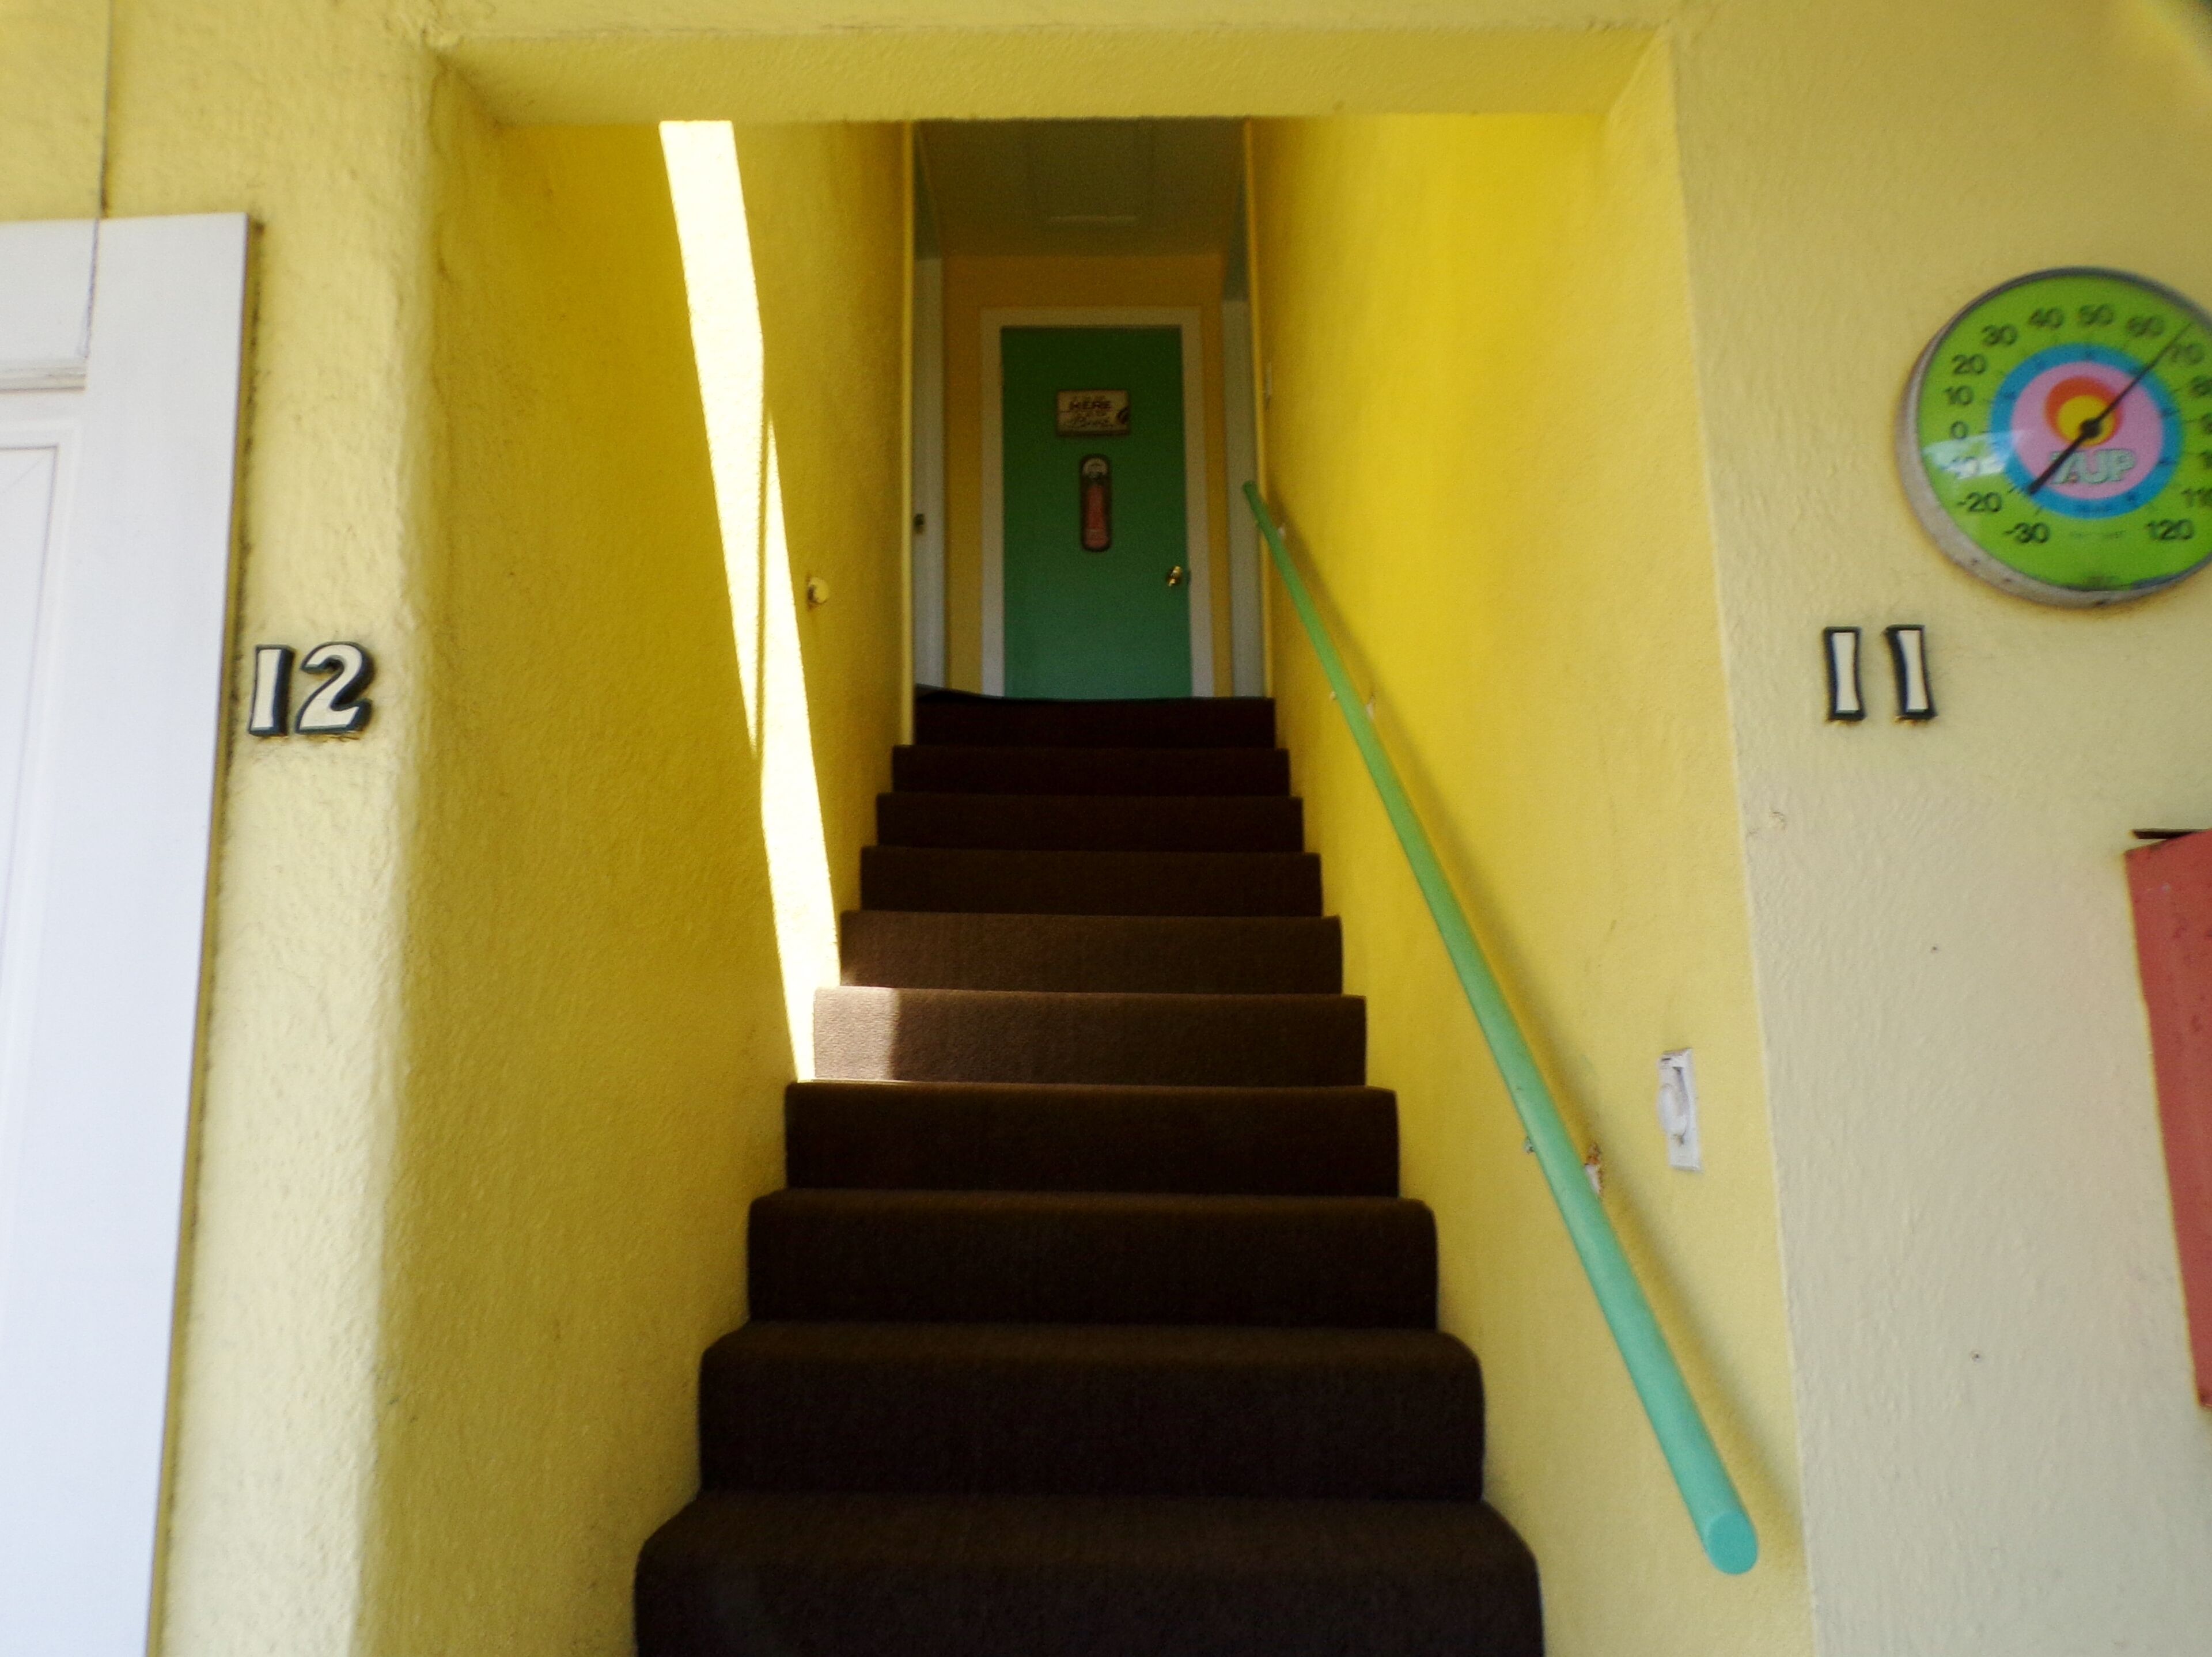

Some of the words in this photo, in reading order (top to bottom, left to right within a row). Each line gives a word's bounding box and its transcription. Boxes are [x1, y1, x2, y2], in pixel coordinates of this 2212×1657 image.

[2028, 306, 2065, 330] 40
[1981, 323, 2018, 346] 30
[1951, 352, 1987, 375] 20
[1944, 385, 1975, 405] 10
[1950, 420, 1969, 440] 0
[1957, 491, 2002, 513] -20
[2003, 522, 2050, 544] -30
[2146, 518, 2194, 540] 120
[1822, 624, 1938, 721] 11
[248, 641, 376, 737] 12
